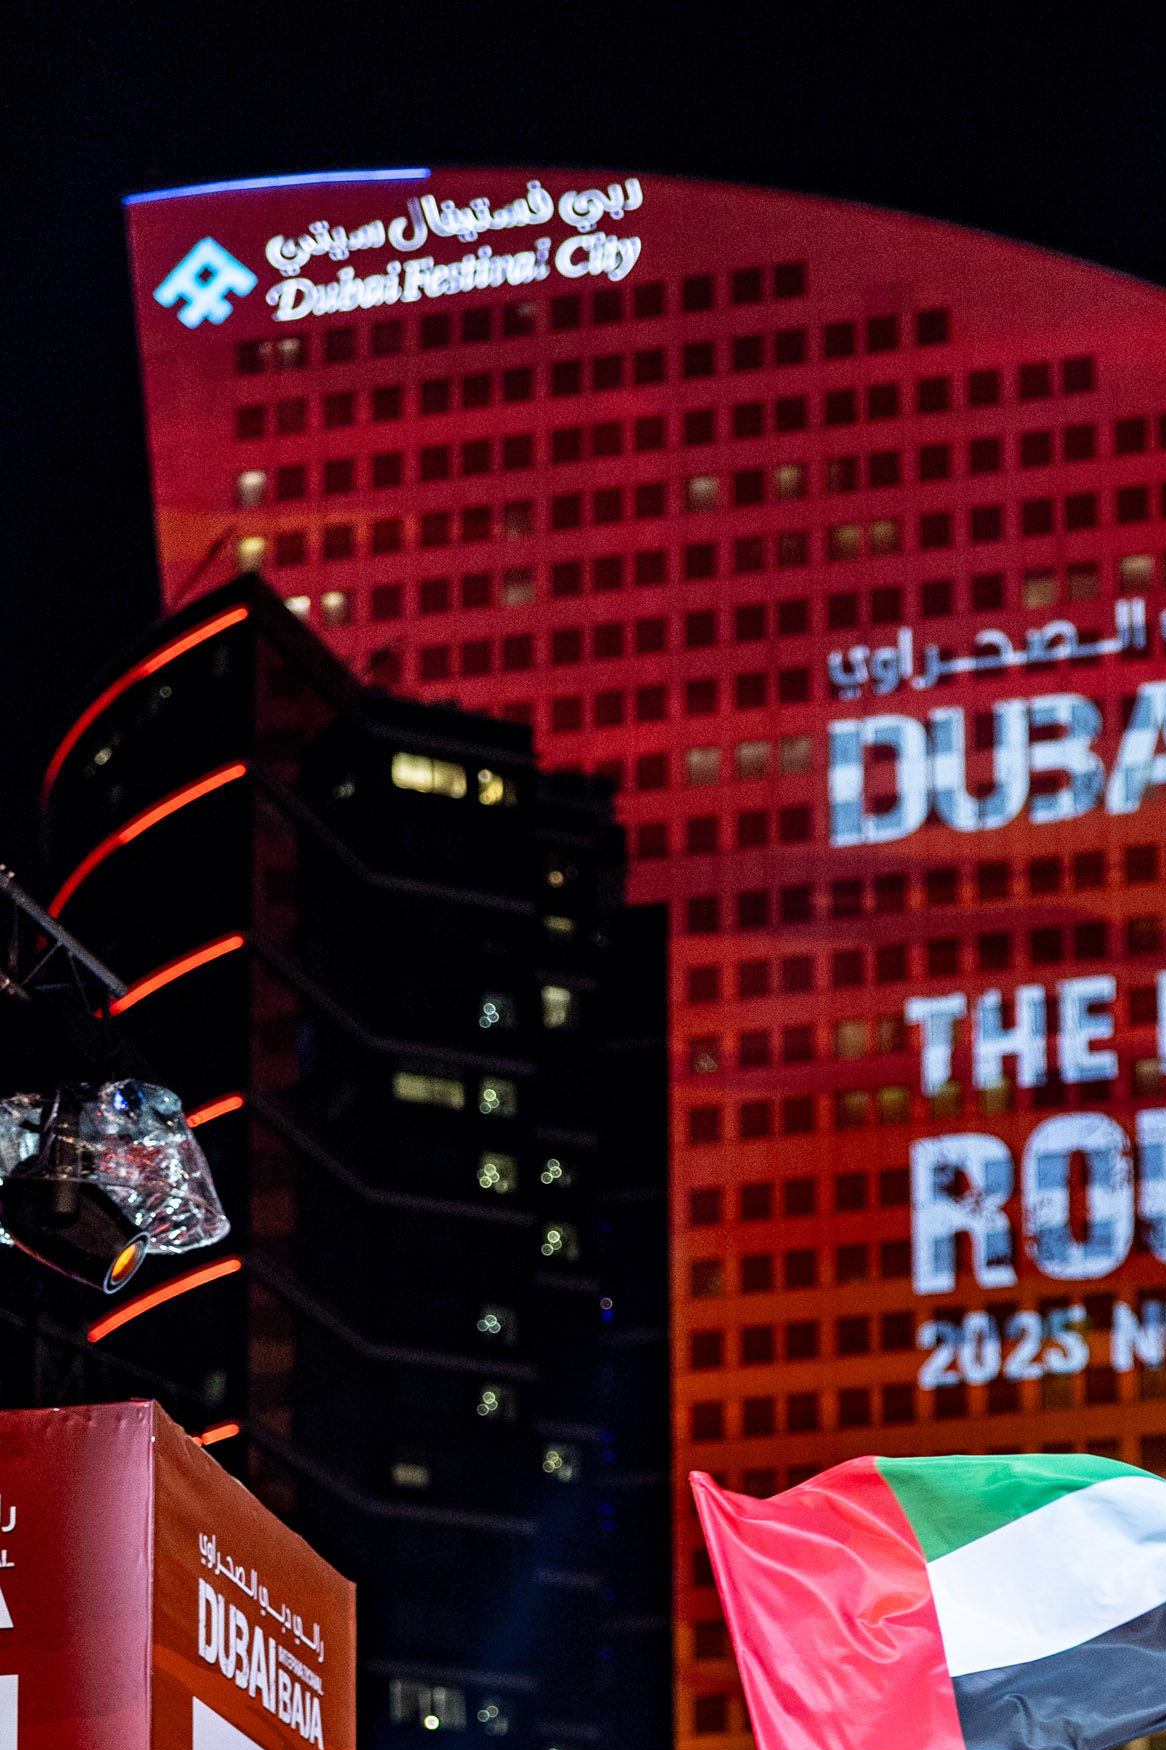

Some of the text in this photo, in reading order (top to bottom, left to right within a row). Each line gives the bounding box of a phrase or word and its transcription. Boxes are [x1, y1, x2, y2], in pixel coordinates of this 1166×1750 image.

[265, 231, 642, 322] Dubai Festival City
[827, 597, 1148, 701] الصحراوي
[905, 974, 1119, 1098] THE
[916, 1303, 1091, 1391] 2025
[198, 1577, 276, 1714] DUBAI
[199, 1532, 325, 1663] رالي دبي الصحراوي
